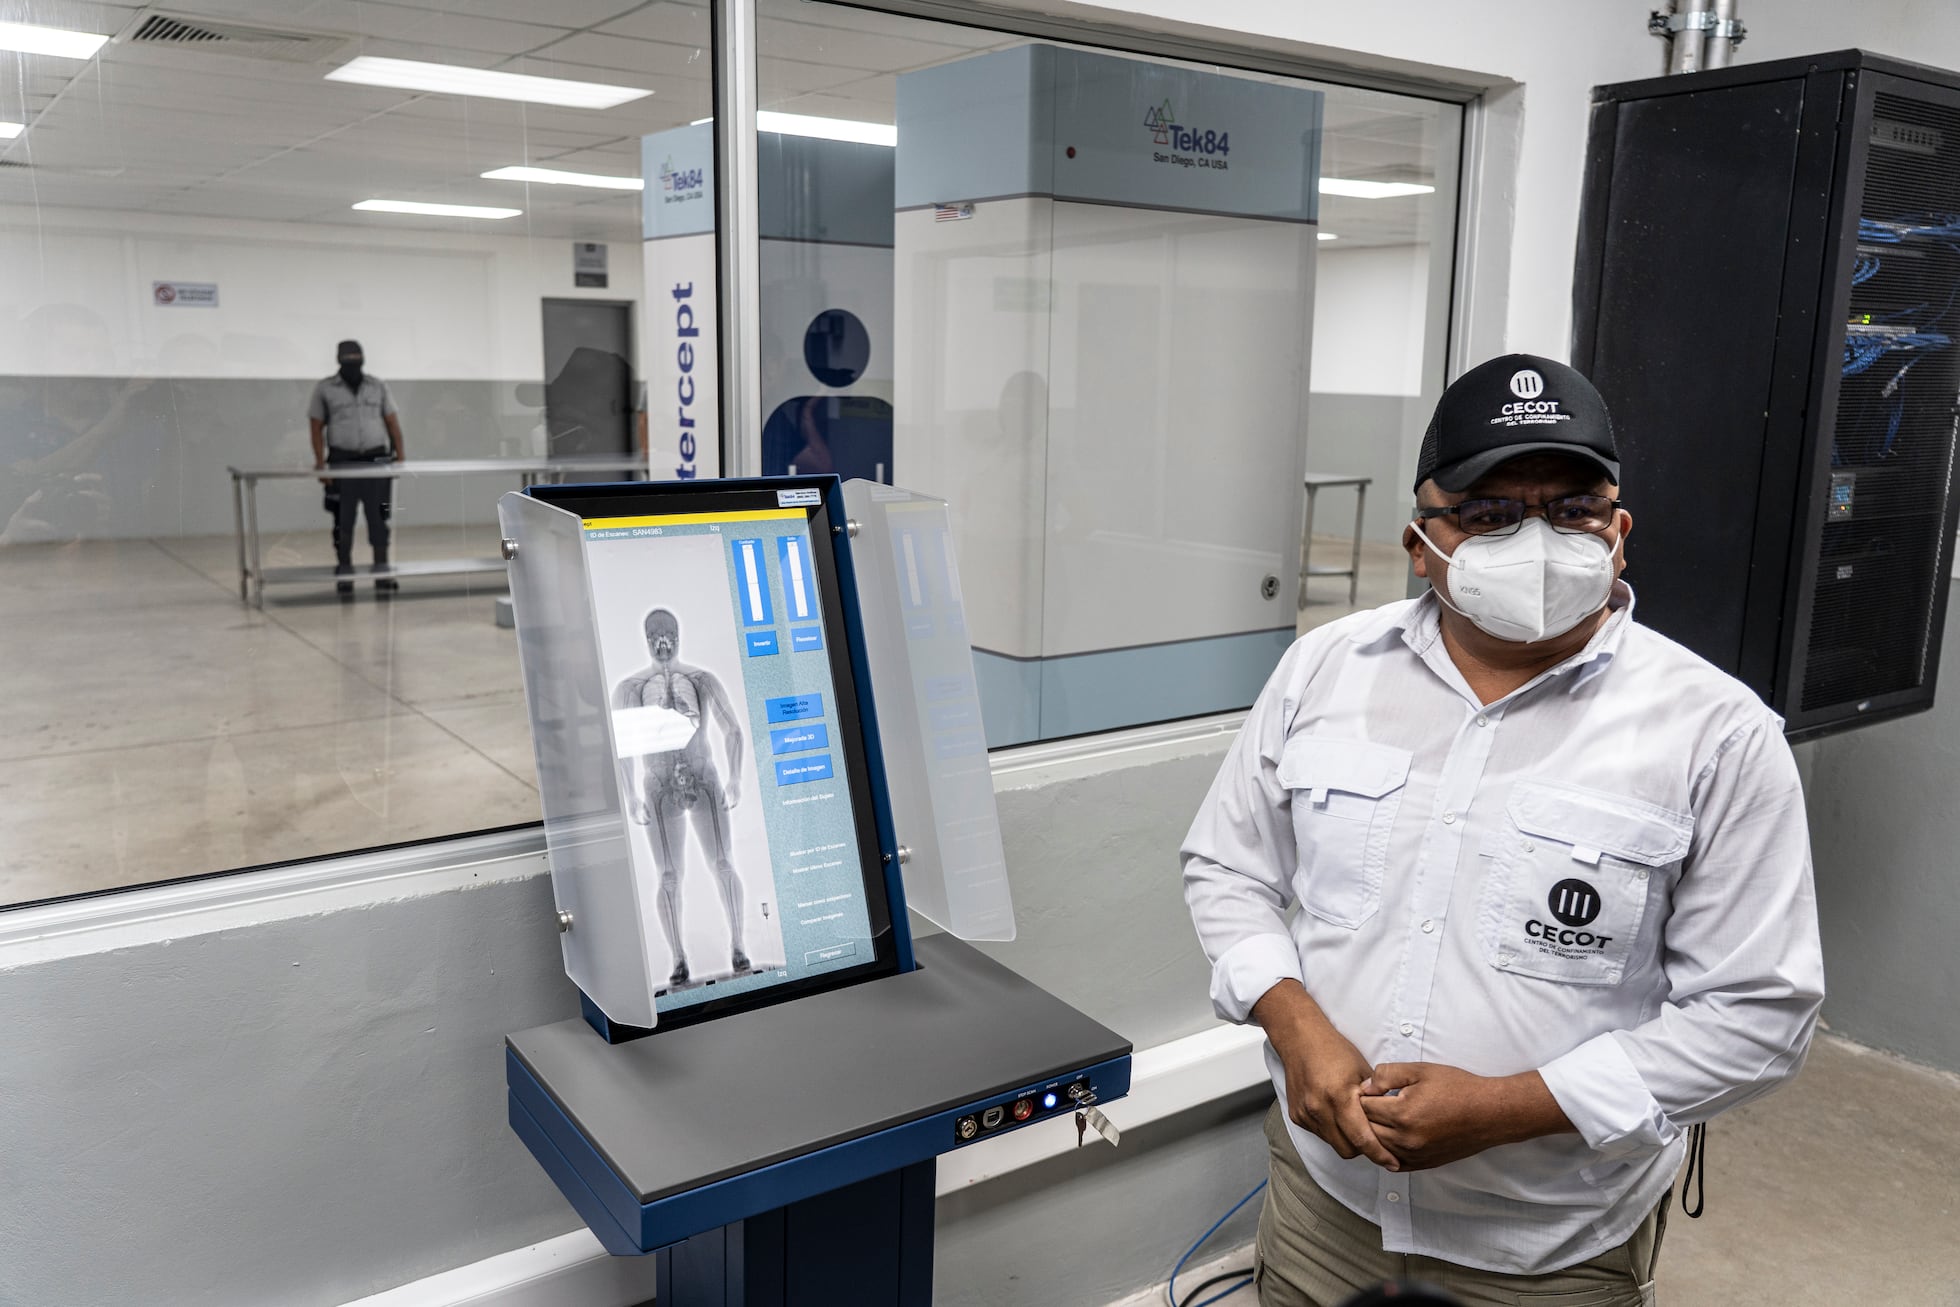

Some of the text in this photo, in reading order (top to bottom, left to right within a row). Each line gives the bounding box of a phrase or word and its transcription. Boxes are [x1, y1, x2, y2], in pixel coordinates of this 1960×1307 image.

[1168, 124, 1229, 156] Tek84
[1153, 152, 1228, 170] San Diego, CA USA
[671, 168, 703, 191] Tek84
[1501, 400, 1559, 415] CECOT
[1490, 415, 1513, 424] CENTRO
[632, 527, 663, 536] SAN4983
[1525, 919, 1613, 949] CECOT
[1523, 938, 1548, 947] CENTRO
[1557, 946, 1604, 955] CONFINAMIENTO
[1551, 949, 1588, 960] TERRORISMO
